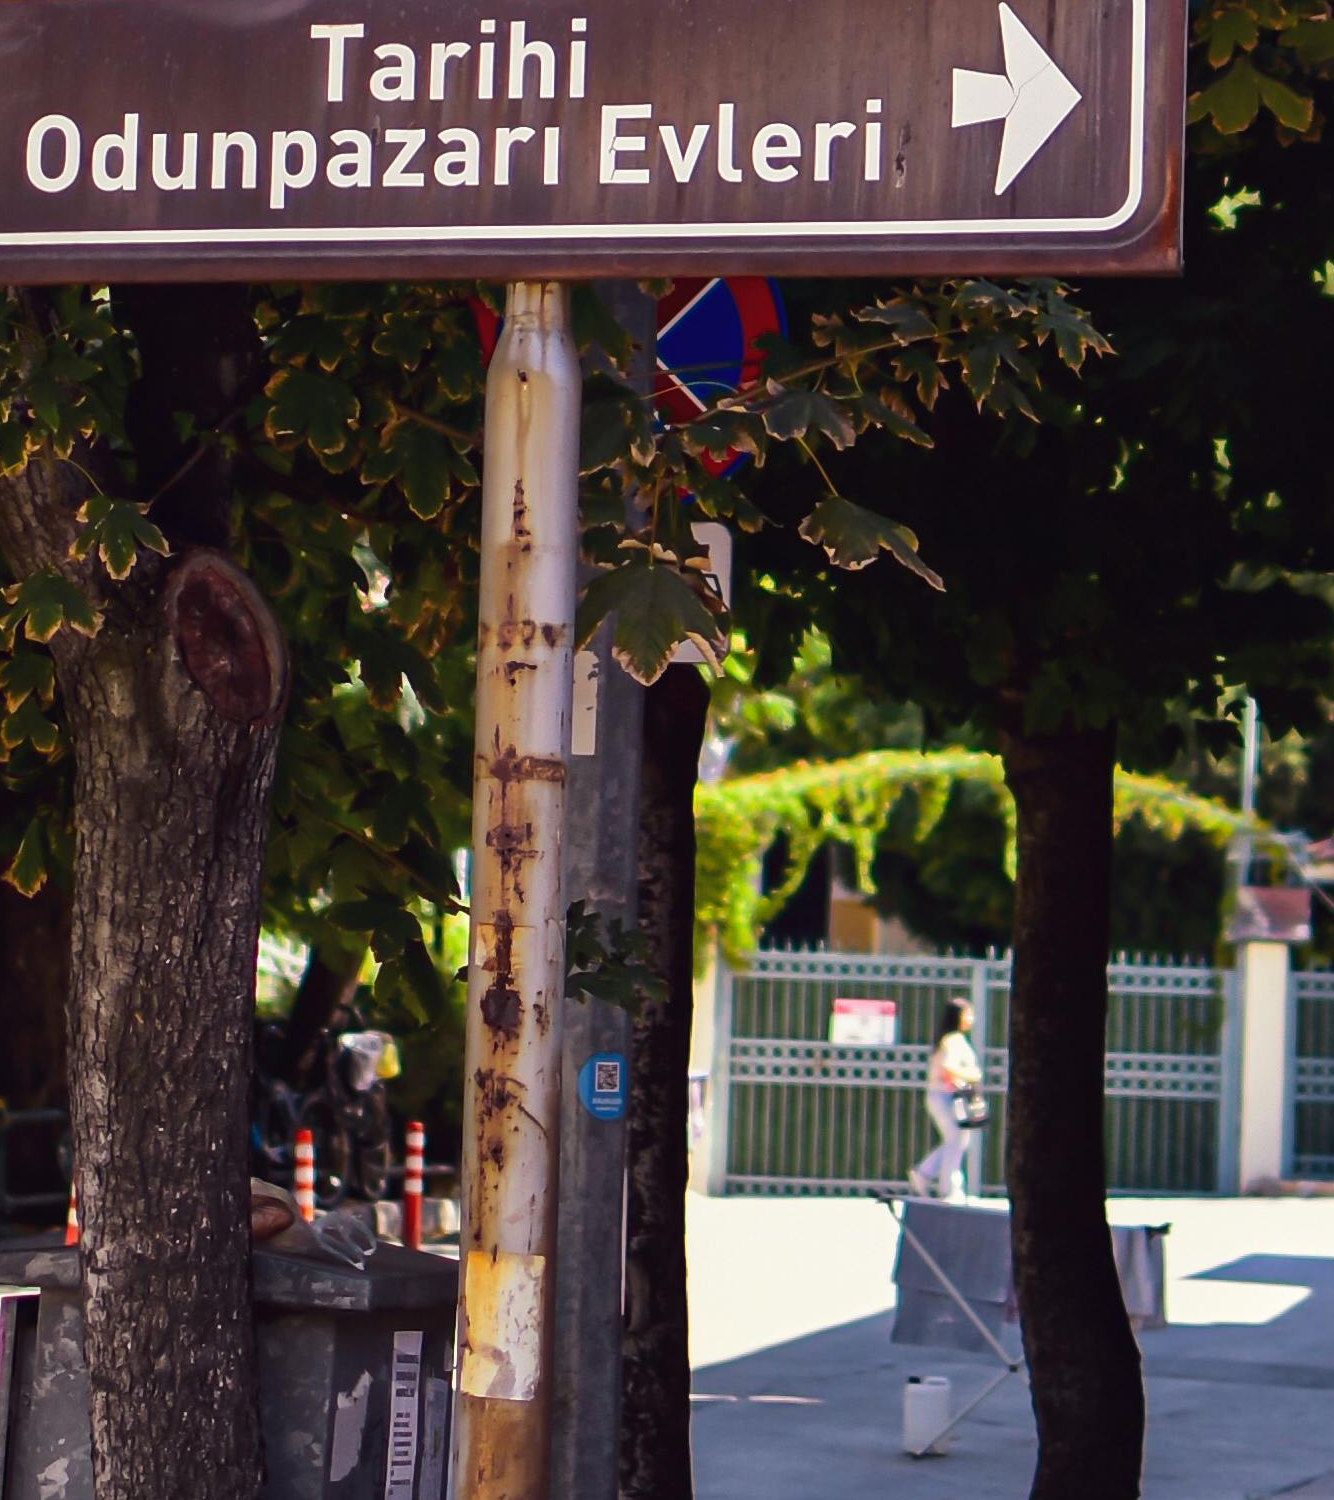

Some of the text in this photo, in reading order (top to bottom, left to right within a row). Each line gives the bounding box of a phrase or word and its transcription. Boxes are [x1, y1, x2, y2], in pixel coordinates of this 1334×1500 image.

[310, 17, 587, 103] Tarihi
[26, 98, 882, 210] Odunpazarı Evleri
